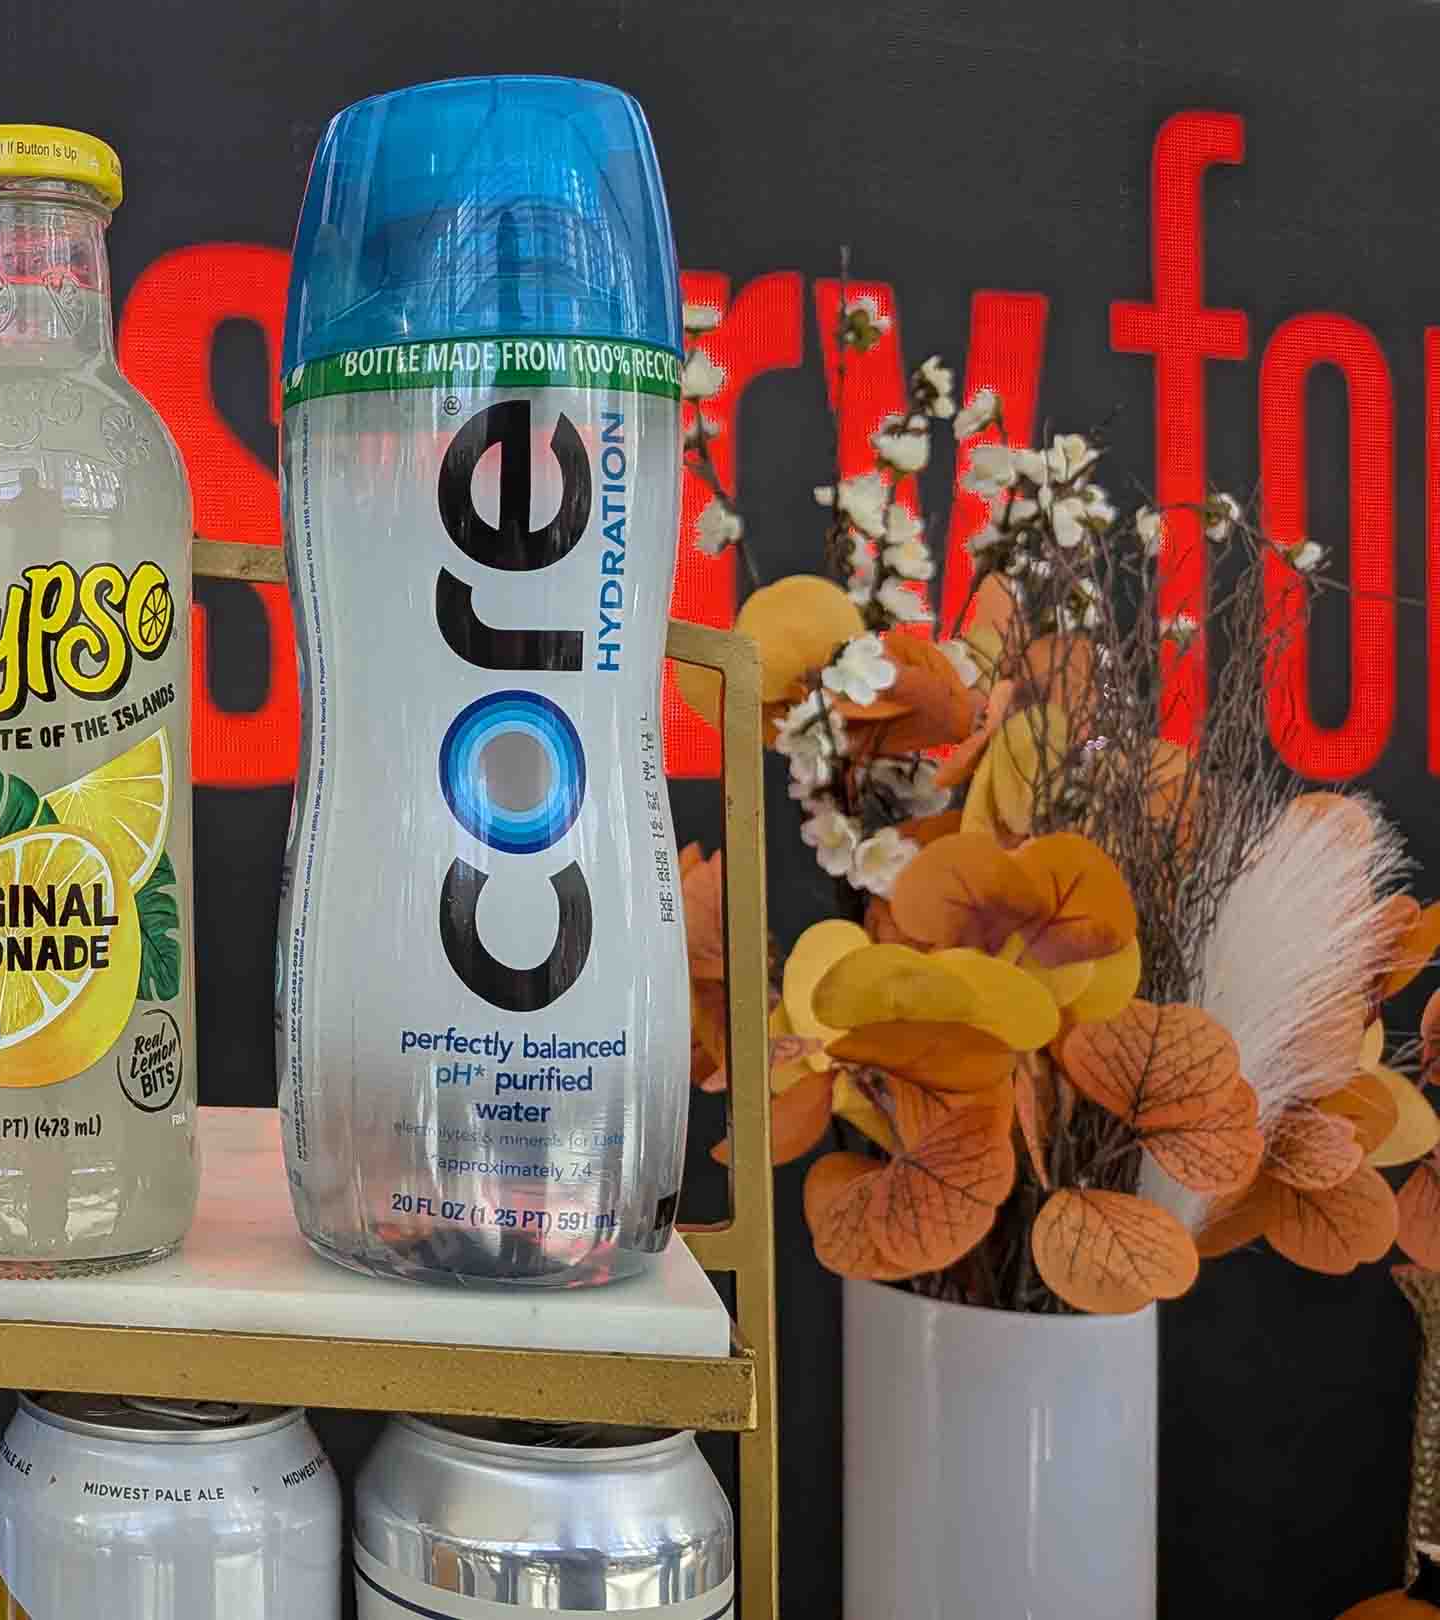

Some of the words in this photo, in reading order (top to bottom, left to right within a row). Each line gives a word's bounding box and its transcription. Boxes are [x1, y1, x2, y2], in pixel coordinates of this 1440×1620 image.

[7, 141, 14, 155] If
[16, 142, 50, 157] Button
[53, 144, 62, 157] Is
[64, 146, 78, 161] Up
[427, 341, 496, 373] MADE
[502, 341, 567, 372] FROM
[572, 342, 632, 377] 100%
[1110, 112, 1440, 782] fo
[597, 411, 628, 672] HYDRATION
[40, 724, 66, 748] OF
[71, 714, 110, 743] THE
[111, 683, 176, 731] ISLANDS
[436, 399, 593, 1013] core
[134, 1022, 166, 1054] Real
[400, 1027, 513, 1060] perfectly
[523, 1030, 627, 1060] balanced
[130, 1043, 177, 1080] Lemon
[142, 1062, 176, 1099] BITS
[495, 1066, 593, 1095] purified
[2, 1116, 29, 1138] PT)
[34, 1115, 70, 1138] (473
[74, 1114, 102, 1137] mL)
[475, 1101, 552, 1124] water
[499, 1132, 562, 1148] minerals
[570, 1162, 593, 1178] 7.4
[391, 1192, 413, 1213] 20
[416, 1196, 435, 1217] FL
[441, 1201, 466, 1221] OZ
[470, 1204, 517, 1228] (1.25
[522, 1208, 553, 1233] PT)
[557, 1211, 589, 1231] 591
[595, 1210, 618, 1230] mL
[14, 1458, 33, 1476] ALE
[83, 1481, 150, 1501] MIDWEST
[155, 1488, 193, 1503] PALE
[197, 1487, 226, 1502] ALE
